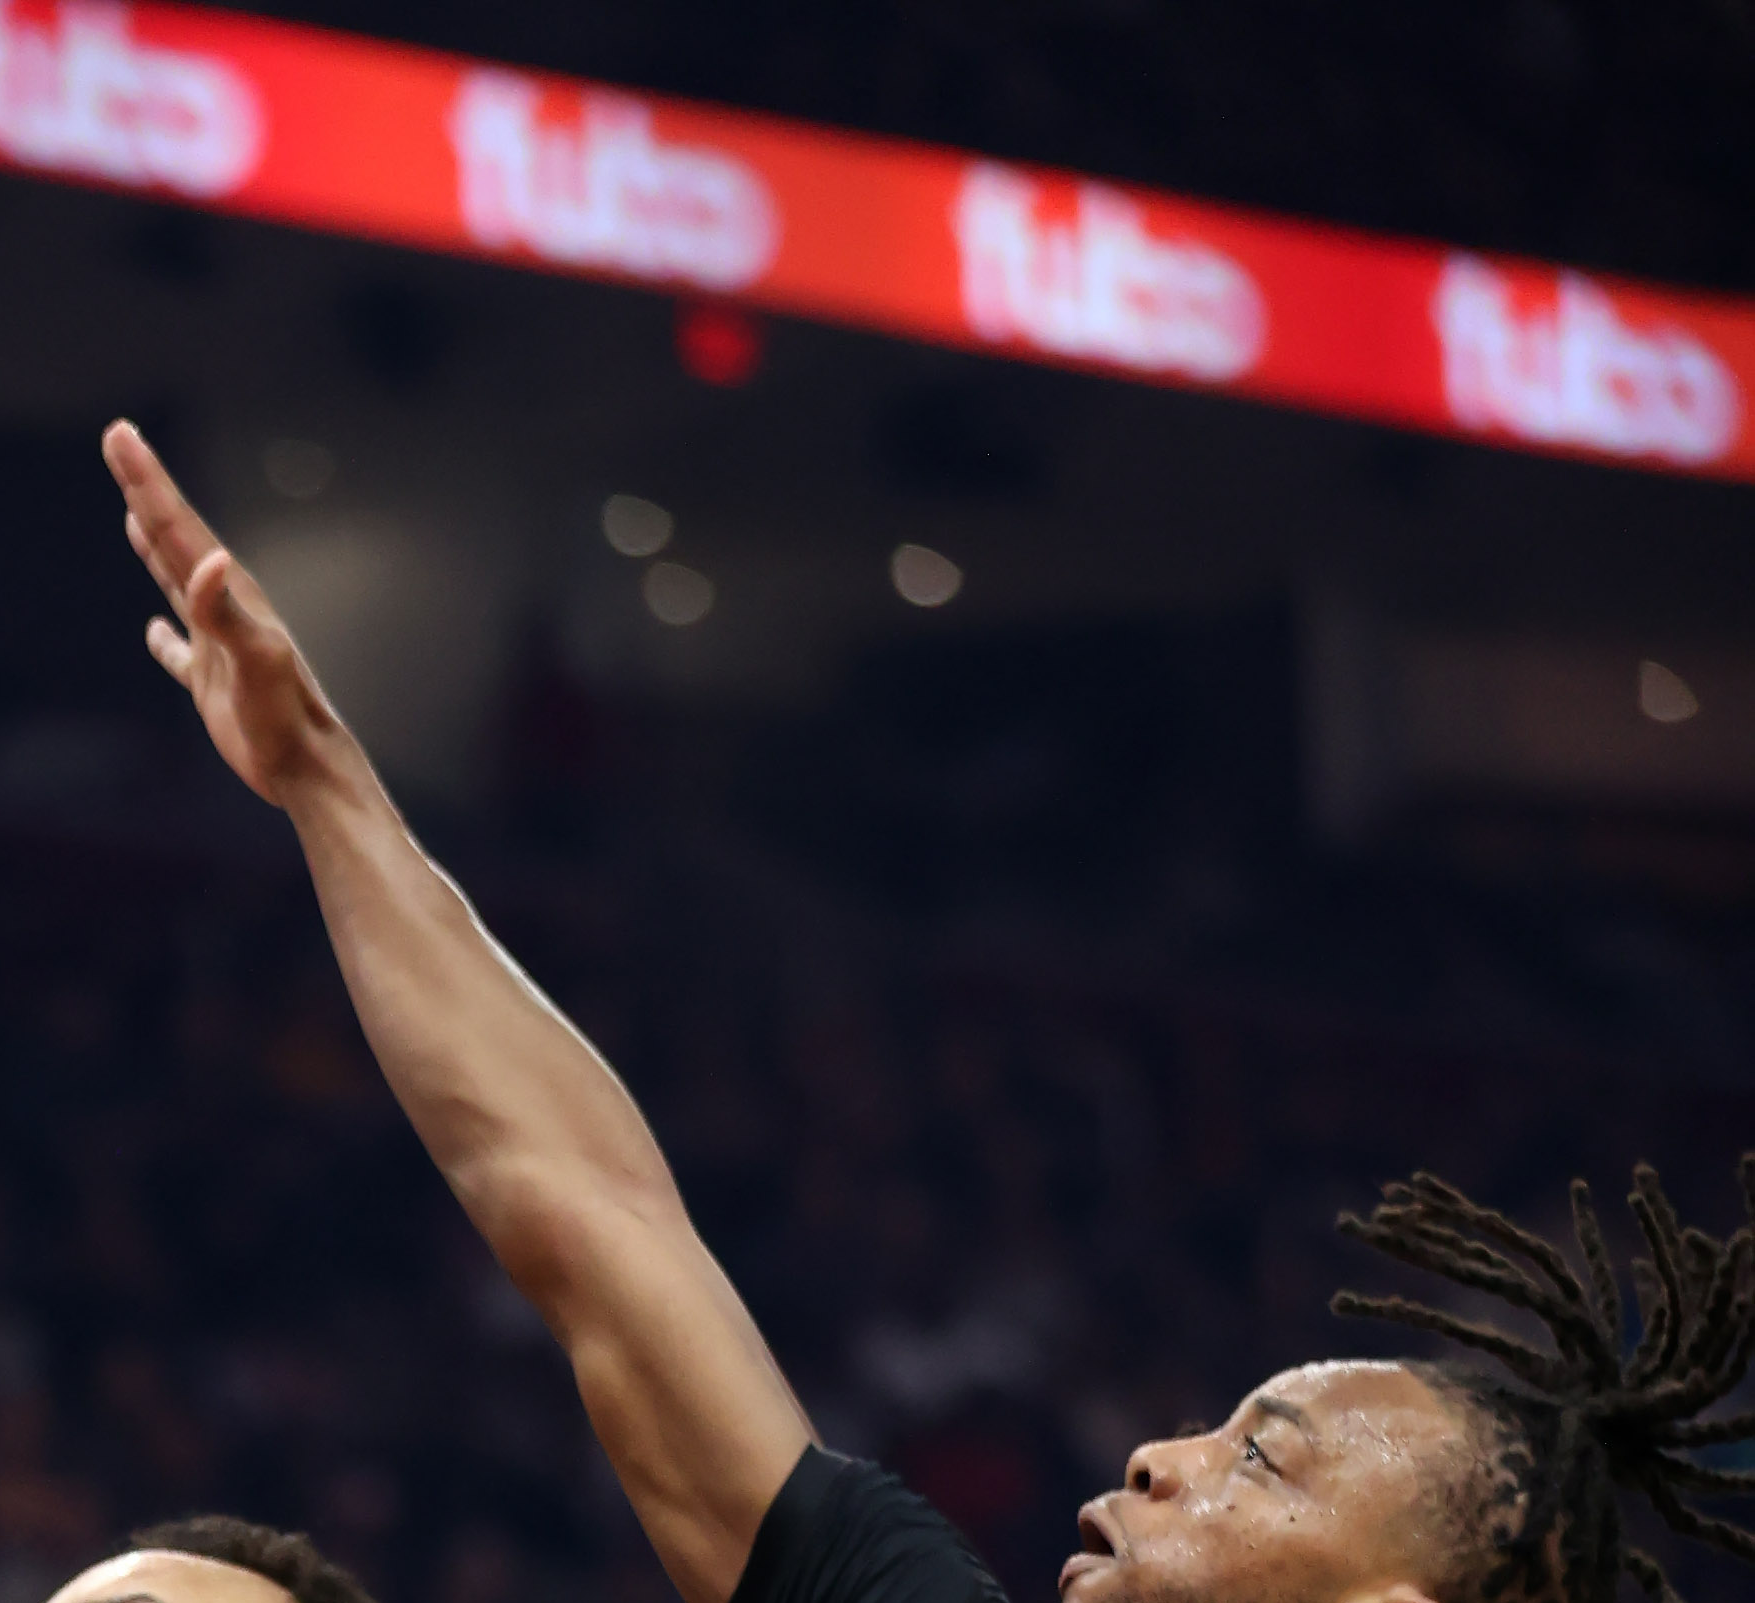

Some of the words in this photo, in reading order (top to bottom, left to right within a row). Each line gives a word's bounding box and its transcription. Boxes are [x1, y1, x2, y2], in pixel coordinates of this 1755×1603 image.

[445, 68, 778, 291] fubo
[949, 160, 1265, 382] fubo
[1430, 252, 1739, 464] fubo
